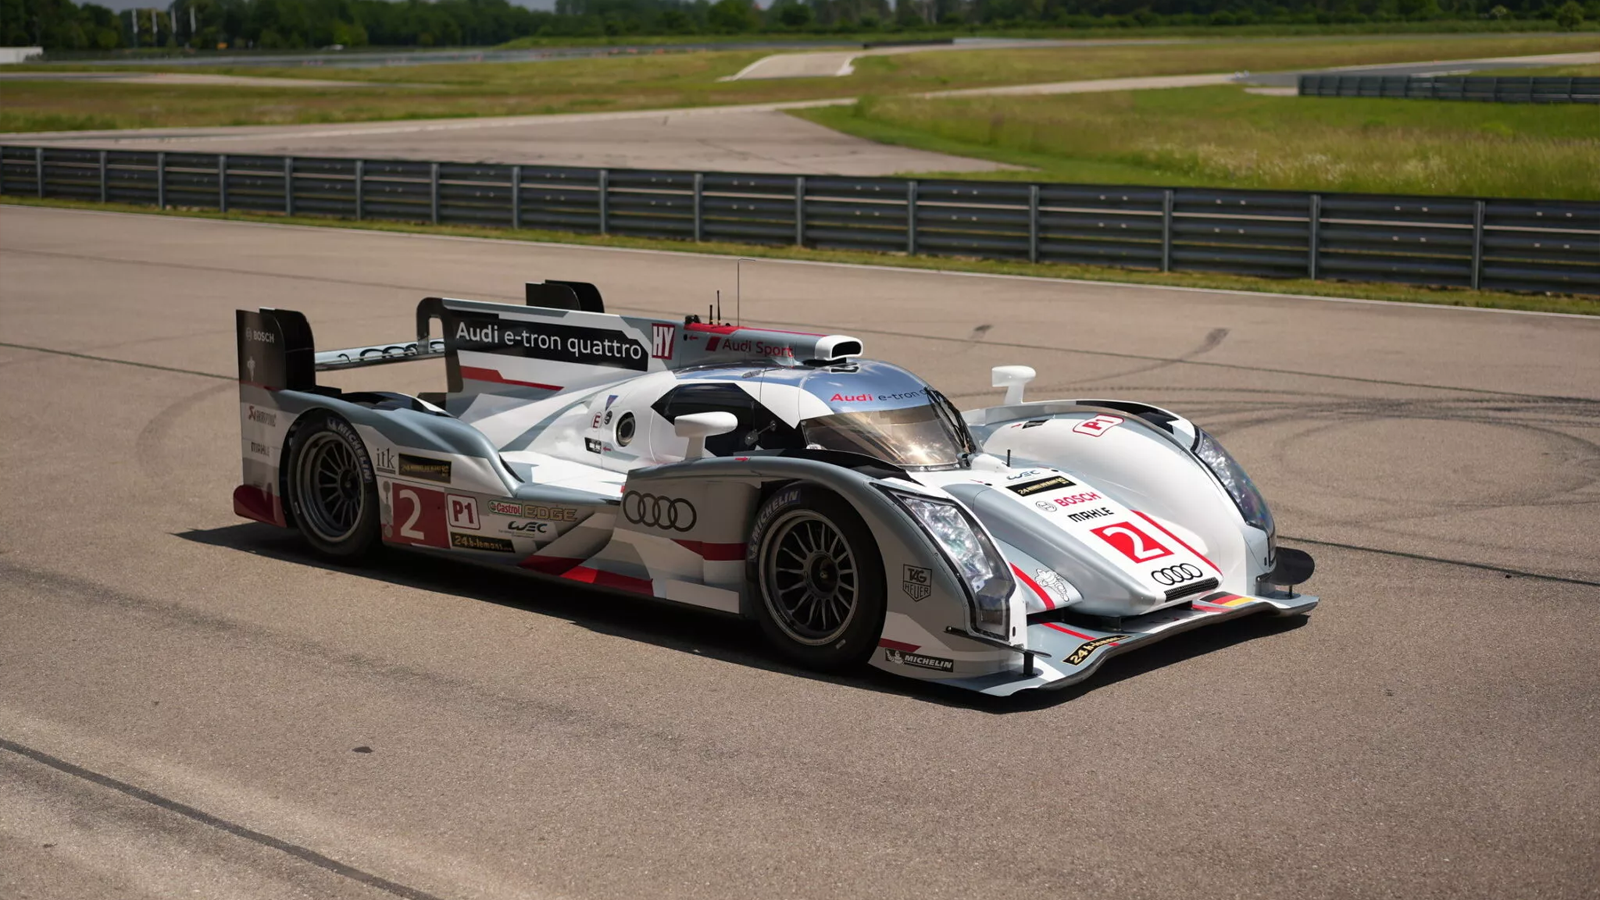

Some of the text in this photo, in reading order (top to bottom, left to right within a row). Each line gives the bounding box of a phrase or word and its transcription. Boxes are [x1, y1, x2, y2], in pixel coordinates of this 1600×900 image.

[253, 330, 275, 343] BOSCH
[456, 321, 643, 360] Audi e-tron quattro
[652, 325, 676, 358] HY
[722, 338, 794, 358] Audi Sport
[830, 393, 874, 402] Audi
[878, 390, 920, 402] e-tron
[1082, 418, 1115, 431] P1
[338, 423, 373, 481] MICHELIN
[376, 447, 395, 469] itk
[1054, 491, 1102, 507] BOSCH
[400, 488, 425, 541] 2
[452, 500, 475, 525] P1
[496, 502, 579, 522] Castrol EDGE
[752, 490, 799, 542] MICHELIN
[1067, 507, 1115, 523] MAHLE
[507, 520, 548, 534] WEC
[1102, 526, 1168, 561] 2
[907, 567, 927, 583] TAG
[905, 583, 929, 600] HEUER
[904, 654, 953, 669] MICHELIN
